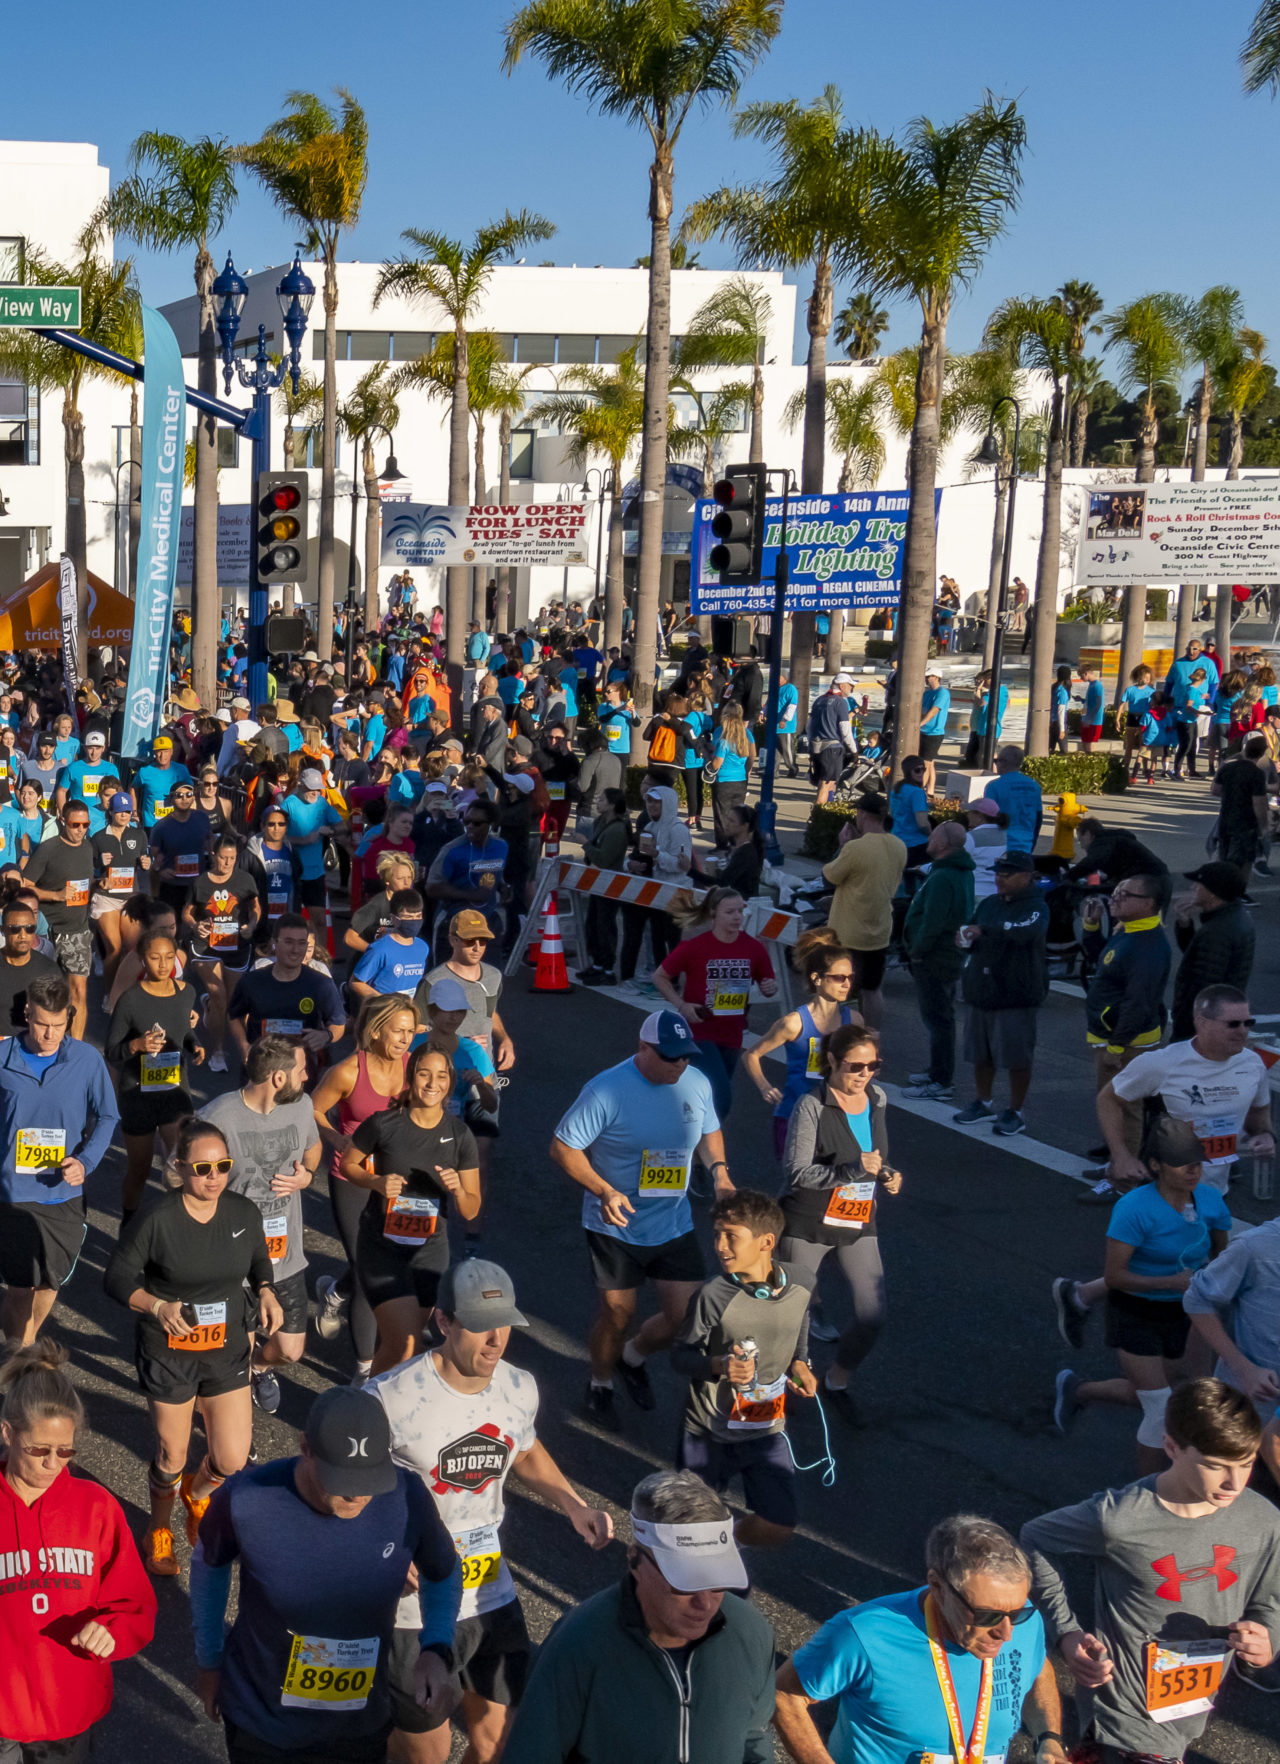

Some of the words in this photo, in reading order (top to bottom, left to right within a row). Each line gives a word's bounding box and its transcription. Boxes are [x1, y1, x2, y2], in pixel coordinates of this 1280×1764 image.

[39, 297, 72, 322] Way
[158, 385, 181, 474] Center
[763, 499, 831, 518] ceanside
[843, 499, 872, 513] 14th
[875, 495, 910, 512] Ann
[1148, 497, 1168, 505] The
[1169, 496, 1209, 505] Friends
[1209, 496, 1220, 504] of
[1222, 495, 1275, 504] Oceanside
[468, 505, 520, 516] NOW
[525, 504, 585, 516] OPEN
[465, 516, 506, 529] FOR
[511, 516, 586, 528] LUNCH
[1147, 514, 1171, 523] Rock
[1174, 514, 1183, 522] &
[1185, 513, 1206, 522] Roll
[1208, 512, 1261, 521] Christmas
[150, 483, 174, 580] Medical
[469, 528, 522, 541] TUES
[538, 528, 580, 540] SAT
[762, 519, 861, 547] Holiday
[865, 517, 907, 542] Tre
[1210, 524, 1259, 533] December
[395, 537, 447, 548] Oceanside
[490, 541, 509, 550] your
[535, 540, 556, 548] lunch
[557, 540, 576, 548] from
[1159, 543, 1214, 551] Oceanside
[1216, 542, 1245, 550] Civic
[487, 548, 524, 556] downtown
[524, 548, 564, 556] restaurant
[1232, 552, 1268, 560] Highway
[405, 556, 434, 564] PATIO
[793, 546, 899, 581] Lighting
[697, 586, 747, 600] December
[747, 585, 766, 598] 2nd
[822, 582, 854, 594] REGAL
[854, 581, 895, 593] CINEMA
[700, 600, 721, 611] Call
[800, 598, 818, 608] for
[819, 599, 850, 608] more
[852, 595, 900, 605] informa
[148, 585, 171, 676] Tri-City
[718, 993, 744, 1006] 8460
[147, 1068, 177, 1081] 8824
[24, 1146, 60, 1162] 7981
[647, 1168, 682, 1184] 9921
[836, 1200, 869, 1217] 4236
[446, 1456, 468, 1474] BJJ
[467, 1454, 505, 1470] OPEN
[337, 1648, 361, 1656] Turkey
[361, 1647, 375, 1655] Trot
[300, 1668, 367, 1692] 8960
[1159, 1665, 1214, 1698] 5531
